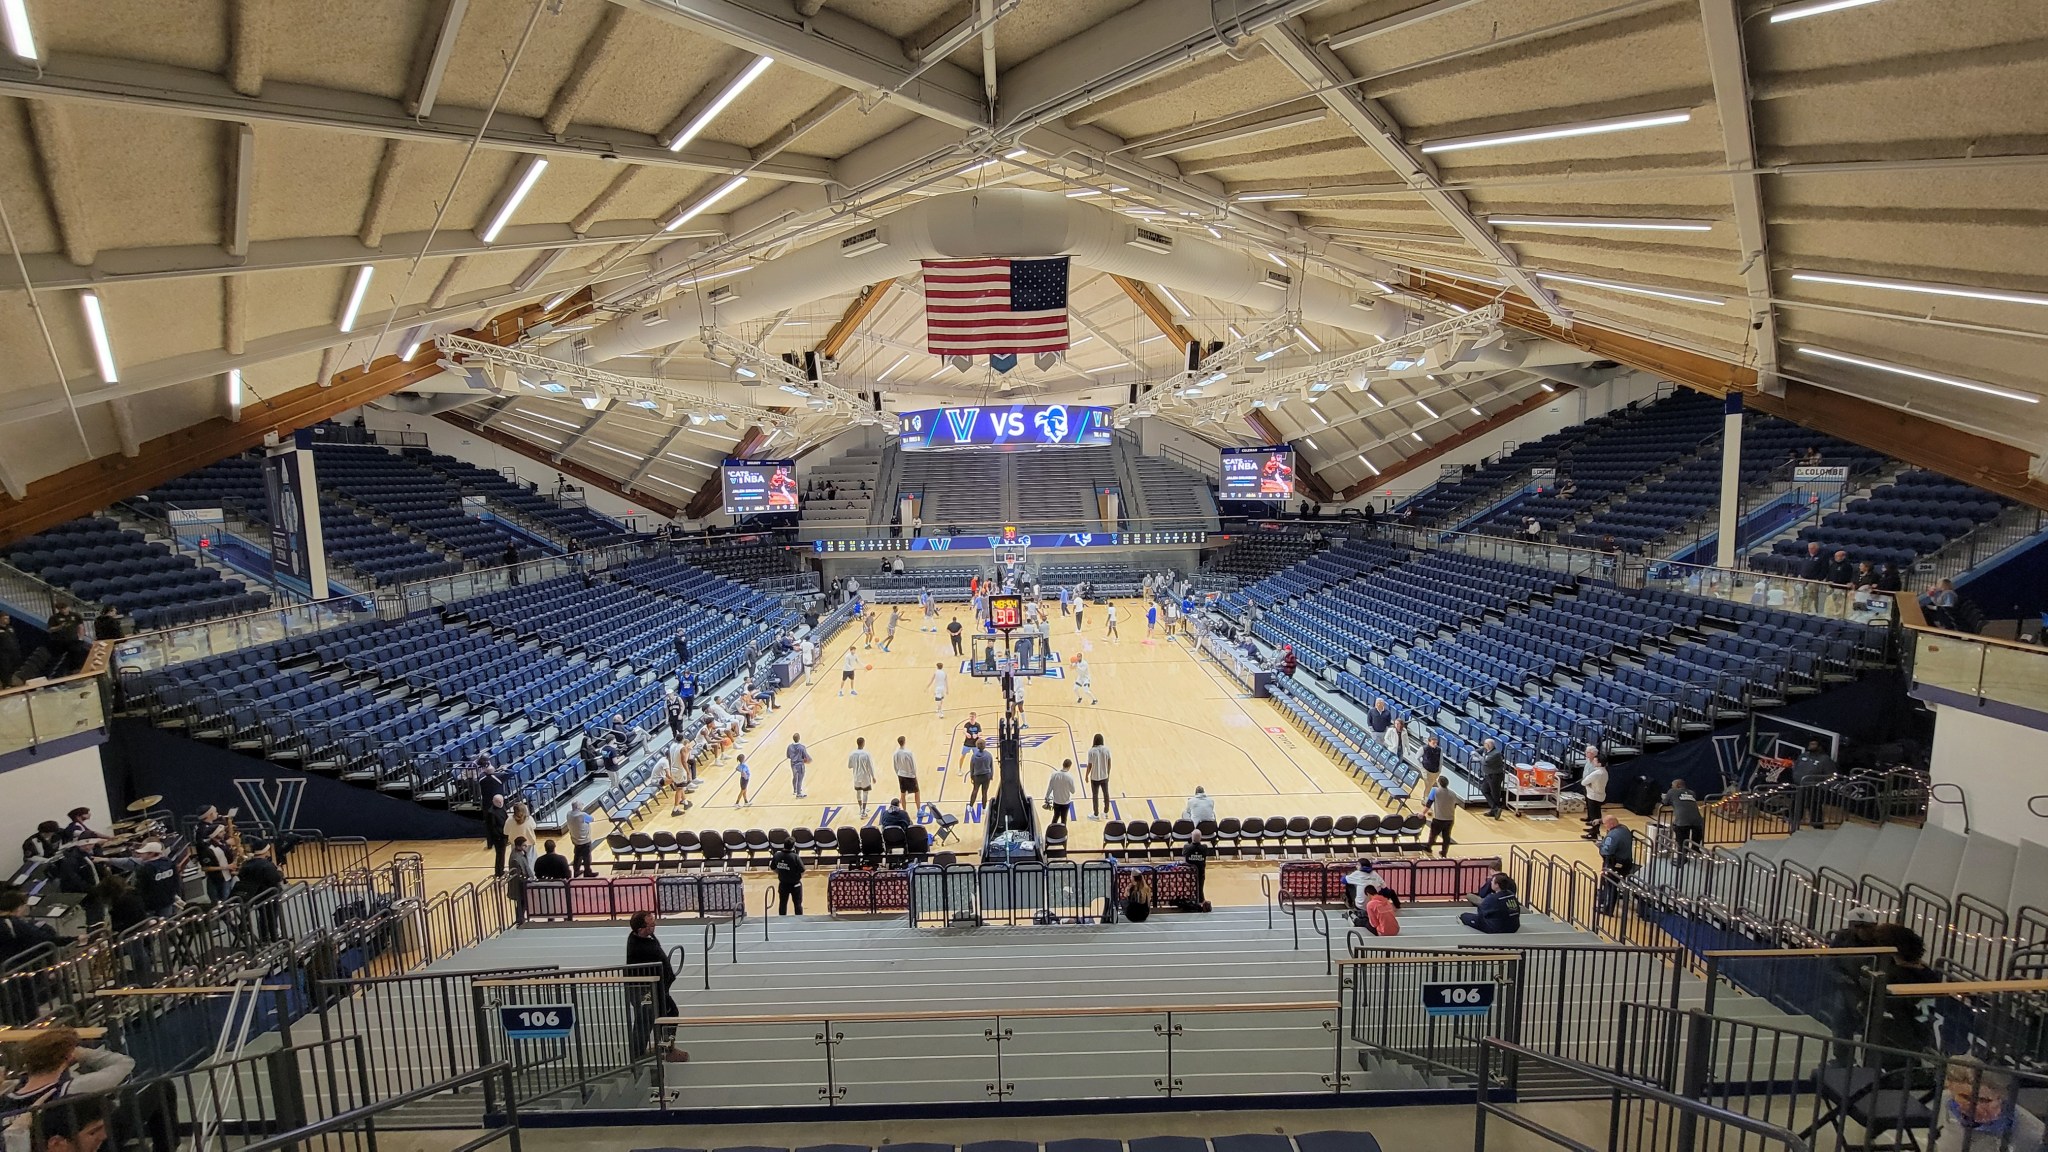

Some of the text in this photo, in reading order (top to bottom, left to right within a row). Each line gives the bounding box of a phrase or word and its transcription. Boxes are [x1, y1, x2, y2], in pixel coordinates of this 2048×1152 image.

[989, 413, 1025, 437] VS
[1238, 462, 1258, 471] NBA
[1804, 468, 1844, 476] COLOMBE
[744, 475, 765, 483] NBA
[1871, 600, 1885, 608] 104
[1440, 988, 1481, 1004] 106
[519, 1011, 560, 1027] 106
